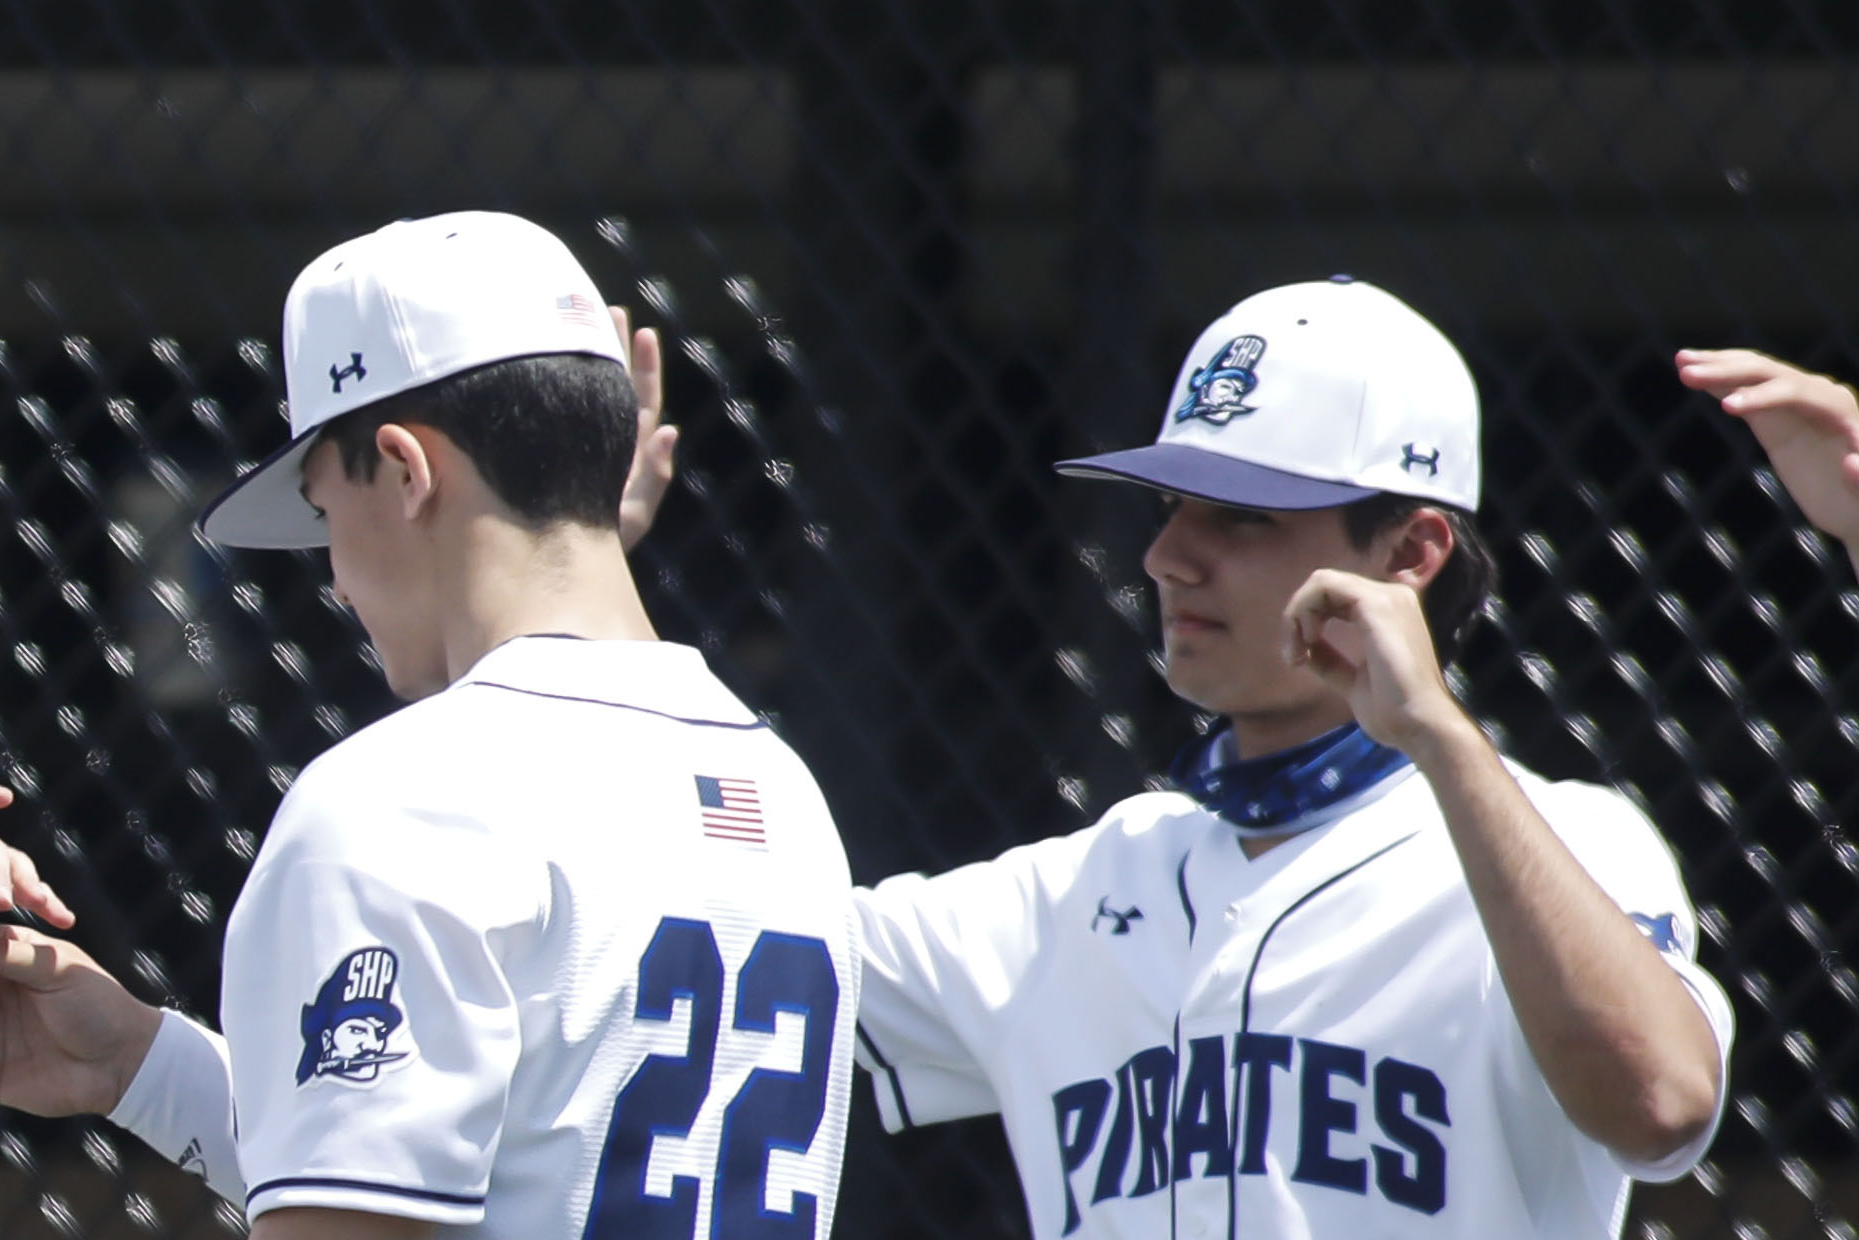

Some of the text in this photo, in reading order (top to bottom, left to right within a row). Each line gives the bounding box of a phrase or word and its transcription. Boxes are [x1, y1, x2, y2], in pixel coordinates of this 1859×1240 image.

[1222, 338, 1263, 367] SHP
[343, 951, 394, 1002] SHP
[1051, 1031, 1452, 1239] PIRATES
